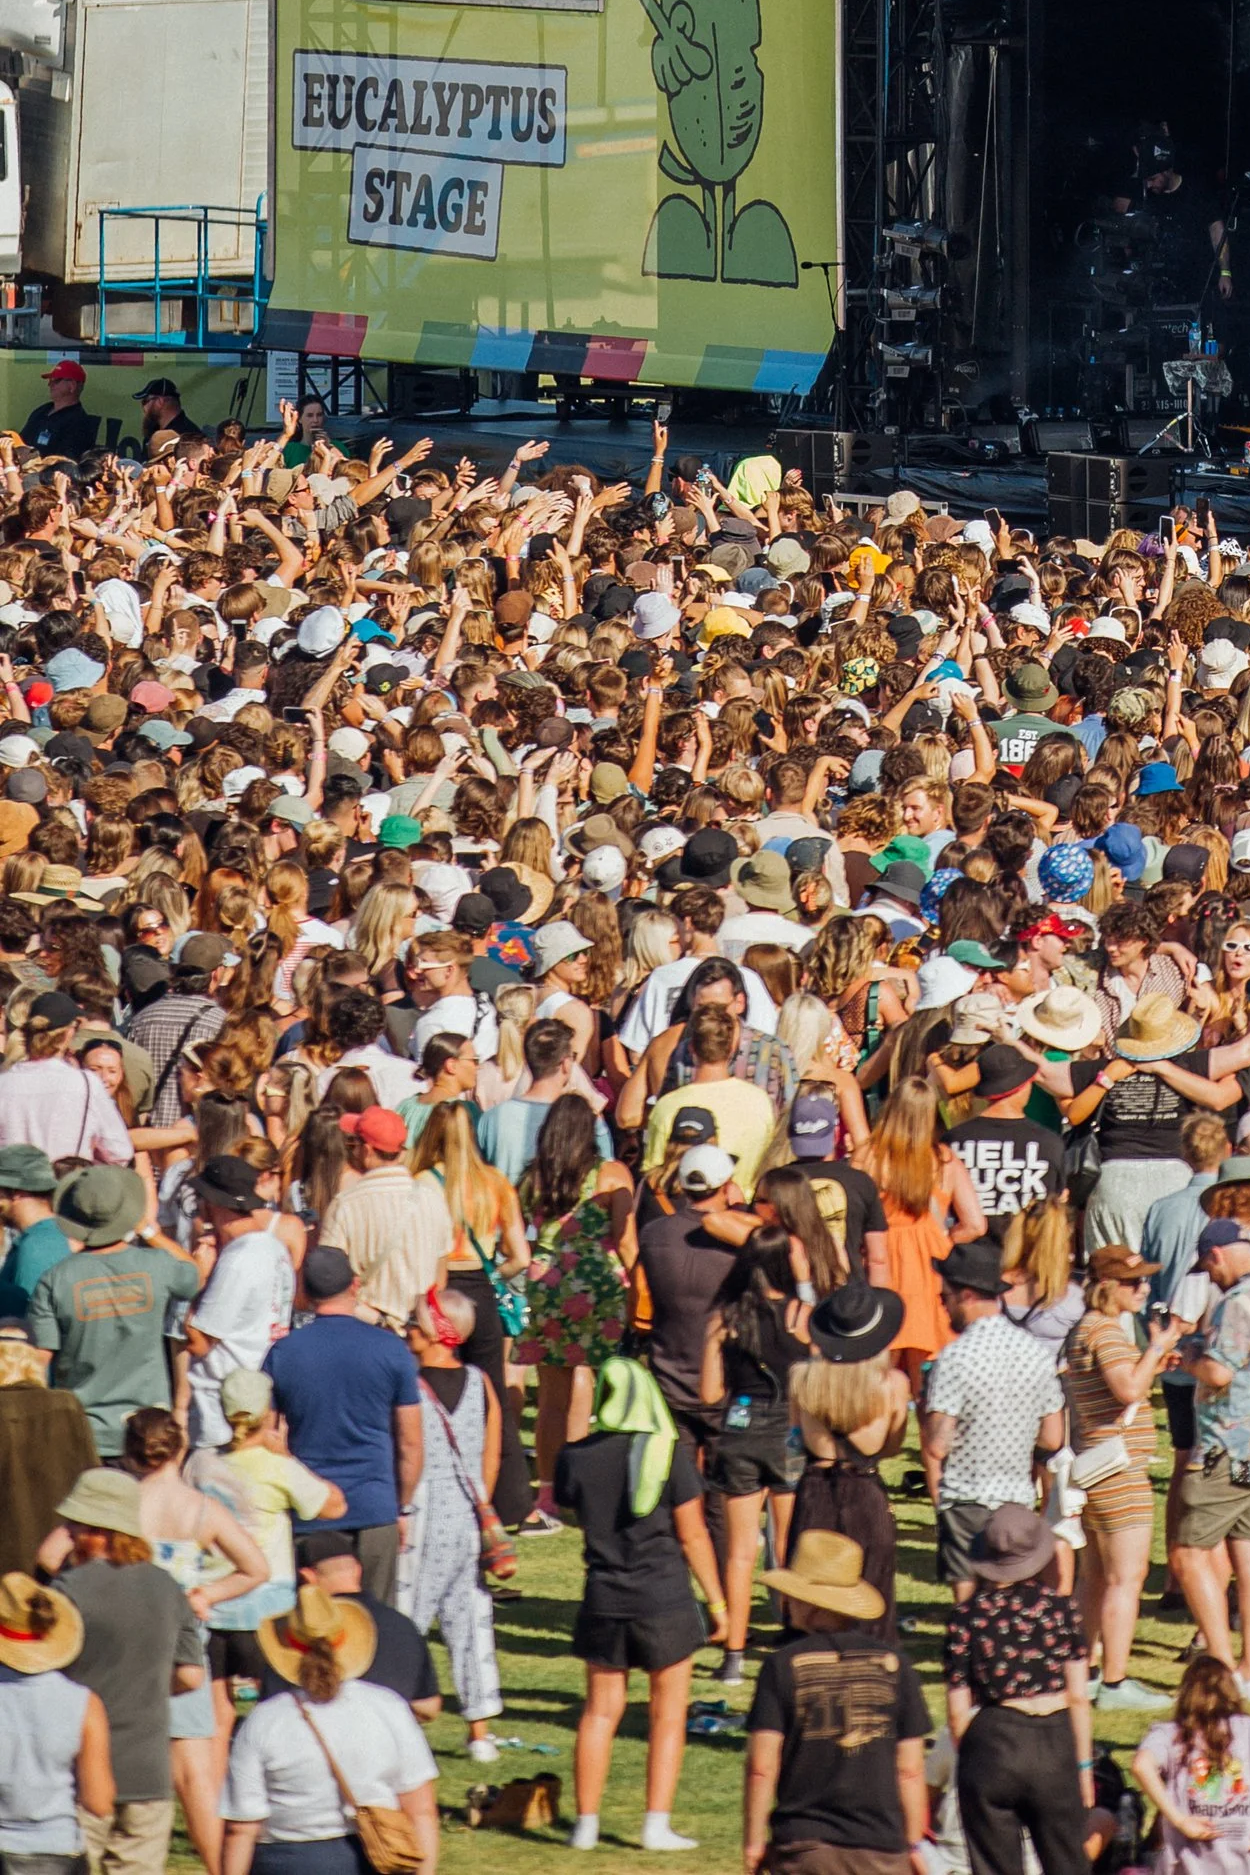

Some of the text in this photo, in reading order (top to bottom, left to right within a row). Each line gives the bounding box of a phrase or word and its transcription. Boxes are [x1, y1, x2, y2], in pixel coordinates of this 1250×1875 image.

[302, 73, 556, 144] EUCALYPTUS
[363, 167, 489, 236] STAGE
[950, 1140, 1049, 1170] HELL
[968, 1167, 1048, 1194] UCK
